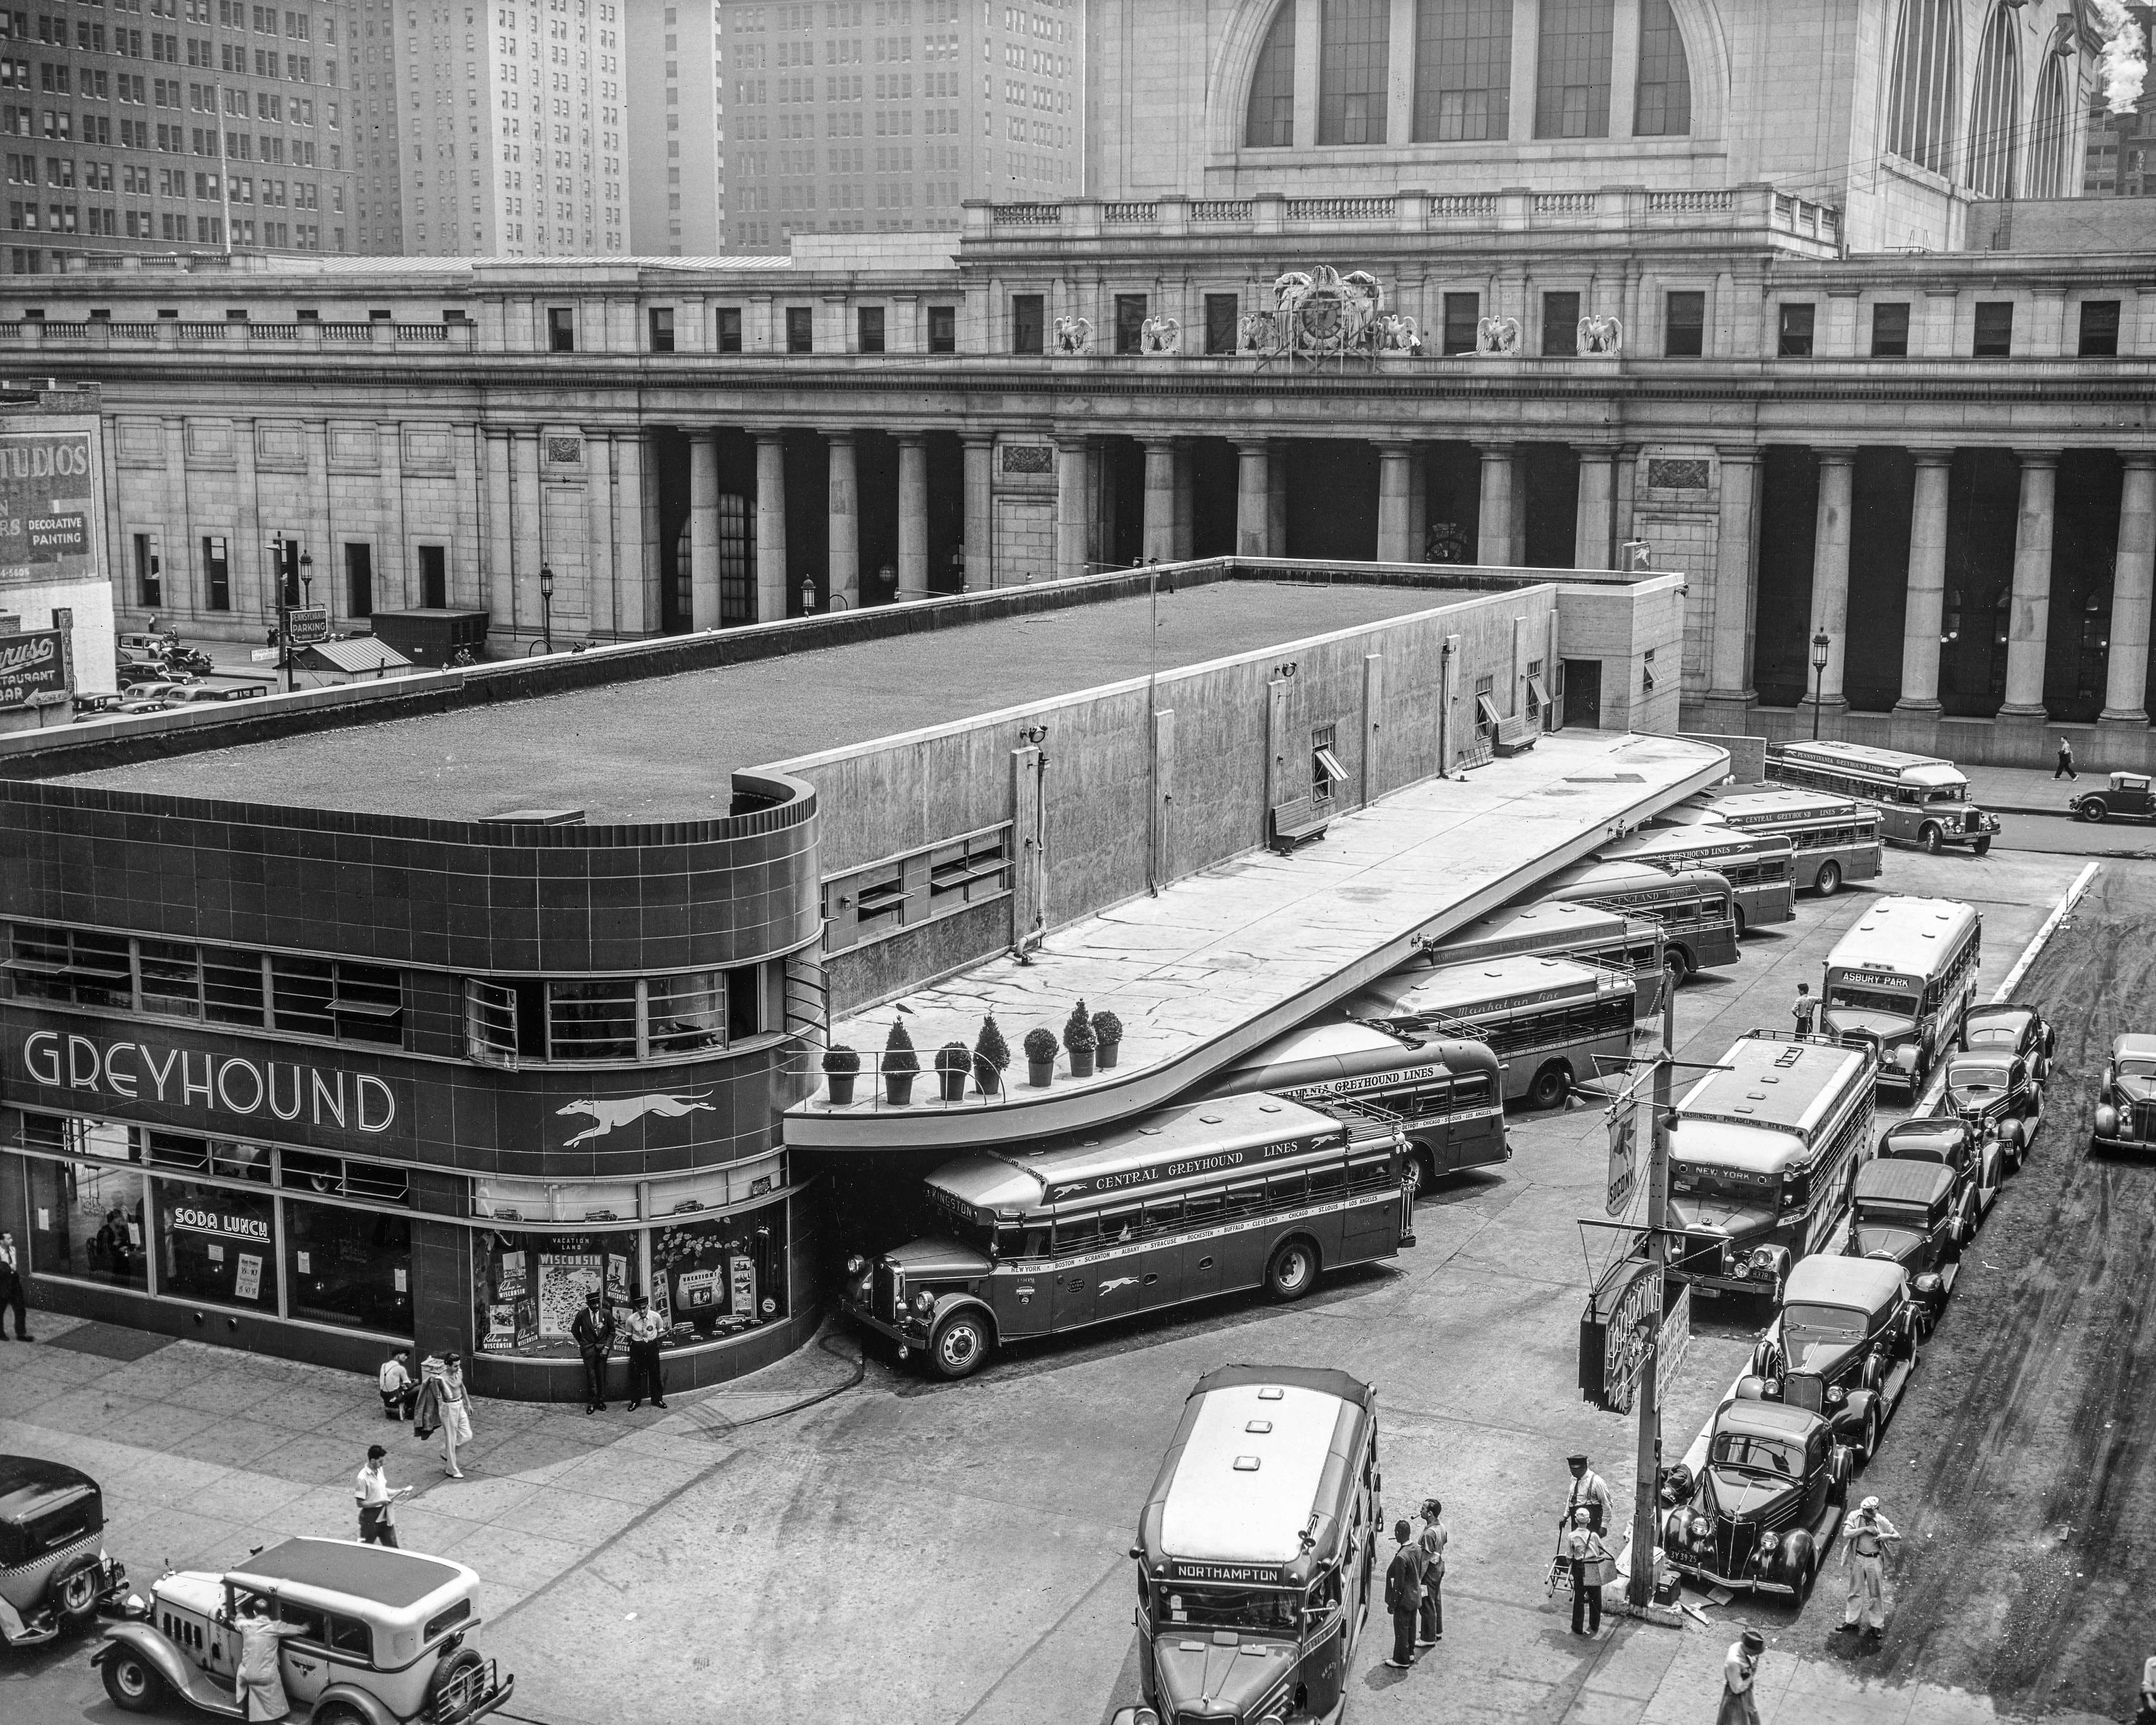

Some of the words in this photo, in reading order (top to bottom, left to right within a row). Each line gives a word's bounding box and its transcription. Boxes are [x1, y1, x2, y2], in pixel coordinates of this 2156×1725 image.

[29, 518, 82, 530] DECORATIVE
[33, 533, 81, 545] PAINTING
[291, 611, 326, 622] PENNSYLVANIA
[292, 622, 326, 632] PARKING
[1797, 753, 1833, 764] PENNSYLVANIA
[1836, 759, 1868, 770] GREYHOUND
[1869, 765, 1884, 773] LINES
[1746, 814, 1773, 824] CENTRAL
[1777, 810, 1812, 821] GREYHOUND
[1820, 809, 1835, 817] LINES
[1711, 846, 1731, 855] LINES
[1618, 892, 1659, 905] ENGLAND
[1843, 972, 1880, 984] ASBURY
[1884, 977, 1909, 988] PARK
[1537, 993, 1560, 1003] Line
[1527, 1044, 1557, 1054] HACKENSACK
[1558, 1038, 1585, 1048] LAKEWOOD
[1586, 1033, 1608, 1041] ATLANTIC
[24, 1031, 395, 1133] GREYHOUND
[1335, 1072, 1400, 1093] GREYHOUND
[1404, 1067, 1434, 1081] LINES
[1682, 1111, 1718, 1121] WASHINGTON
[1723, 1115, 1761, 1127] PHILADELPHIA
[1767, 1121, 1780, 1130] NEW
[1781, 1123, 1797, 1133] YORK
[1096, 1168, 1159, 1190] CENTRAL
[1168, 1151, 1243, 1176] GREYHOUND
[1263, 1140, 1299, 1158] LINES
[1026, 1167, 1044, 1182] CHICAGO
[1695, 1166, 1718, 1177] NEW
[1723, 1170, 1750, 1181] YORK
[1609, 1167, 1634, 1206] SOCONY
[932, 1187, 972, 1218] KINGSTON
[175, 1208, 218, 1229] SODA
[224, 1215, 267, 1237] LUNCH
[1024, 1264, 1041, 1273] YORK
[1055, 1259, 1075, 1269] BOSTON
[1084, 1252, 1111, 1263] SCRANTON
[1121, 1245, 1141, 1255] ALBANY
[1150, 1238, 1177, 1249] SYRACUSE
[1187, 1230, 1215, 1241] ROCHESTER
[1224, 1223, 1245, 1233] BUFFALO
[1252, 1216, 1279, 1227] CLEVELAND
[1288, 1210, 1309, 1220] CHICAGO
[1359, 1195, 1378, 1205] ANGELES
[540, 1254, 602, 1266] WISCONSIN
[683, 1272, 717, 1282] VACATION!
[498, 1280, 515, 1292] Relax
[607, 1282, 620, 1293] Relax
[499, 1288, 526, 1299] WISCONSIN
[607, 1291, 629, 1302] WISCONSIN
[484, 1333, 502, 1344] Relax
[517, 1330, 530, 1342] Relax
[517, 1335, 538, 1348] WISCONSIN
[613, 1336, 629, 1347] Relax
[613, 1343, 630, 1352] WISCON
[1178, 1565, 1278, 1581] NORTHAMPTON
